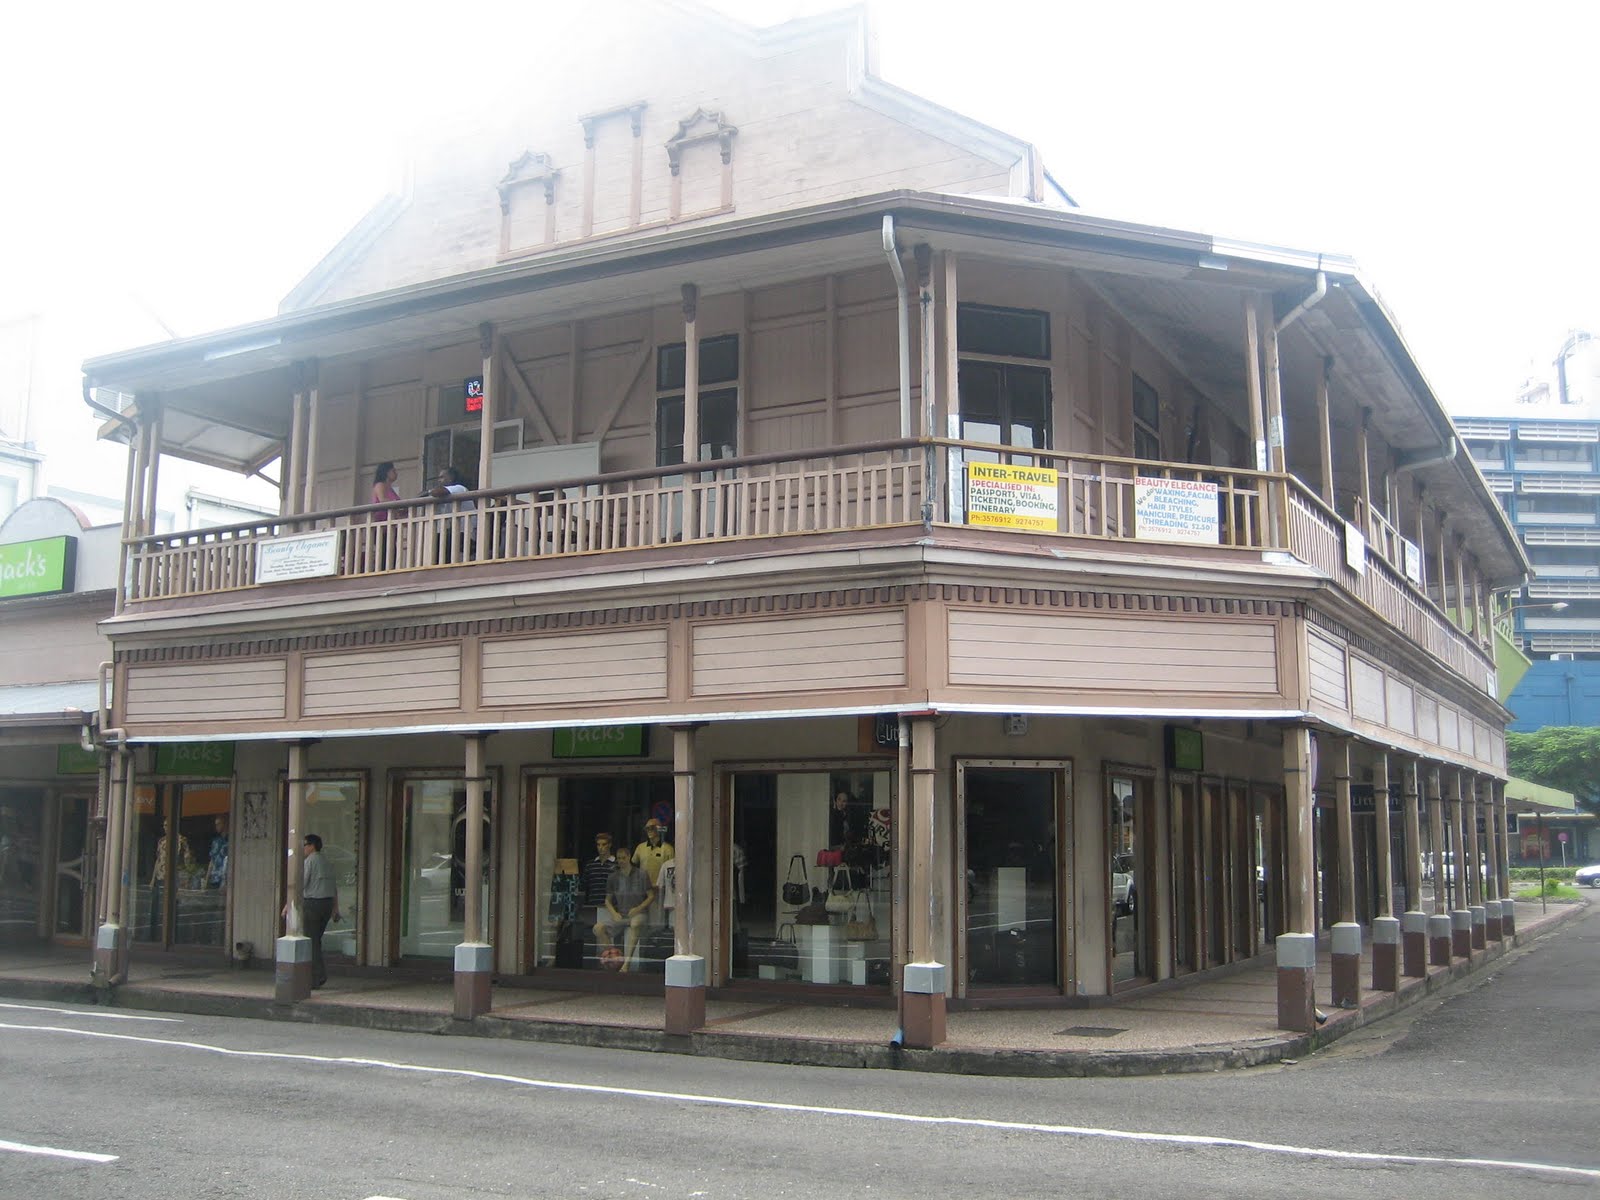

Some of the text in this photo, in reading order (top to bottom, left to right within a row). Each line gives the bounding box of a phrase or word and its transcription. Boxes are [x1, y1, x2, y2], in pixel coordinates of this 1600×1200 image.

[974, 466, 1054, 483] INTER-TRAVEL
[971, 480, 1022, 491] SPECIALISED
[1135, 478, 1216, 492] BEAUTY ELEGANCE
[970, 488, 1044, 502] PASSPORTS, VISAS,
[1154, 496, 1199, 507] BLEACHING,
[971, 503, 1016, 514] ITINERARY
[1147, 503, 1195, 514] HAIR STYLES,
[1137, 509, 1179, 520] MANICURE,
[1015, 518, 1044, 527] 9274757
[1143, 517, 1189, 529] (THREADING
